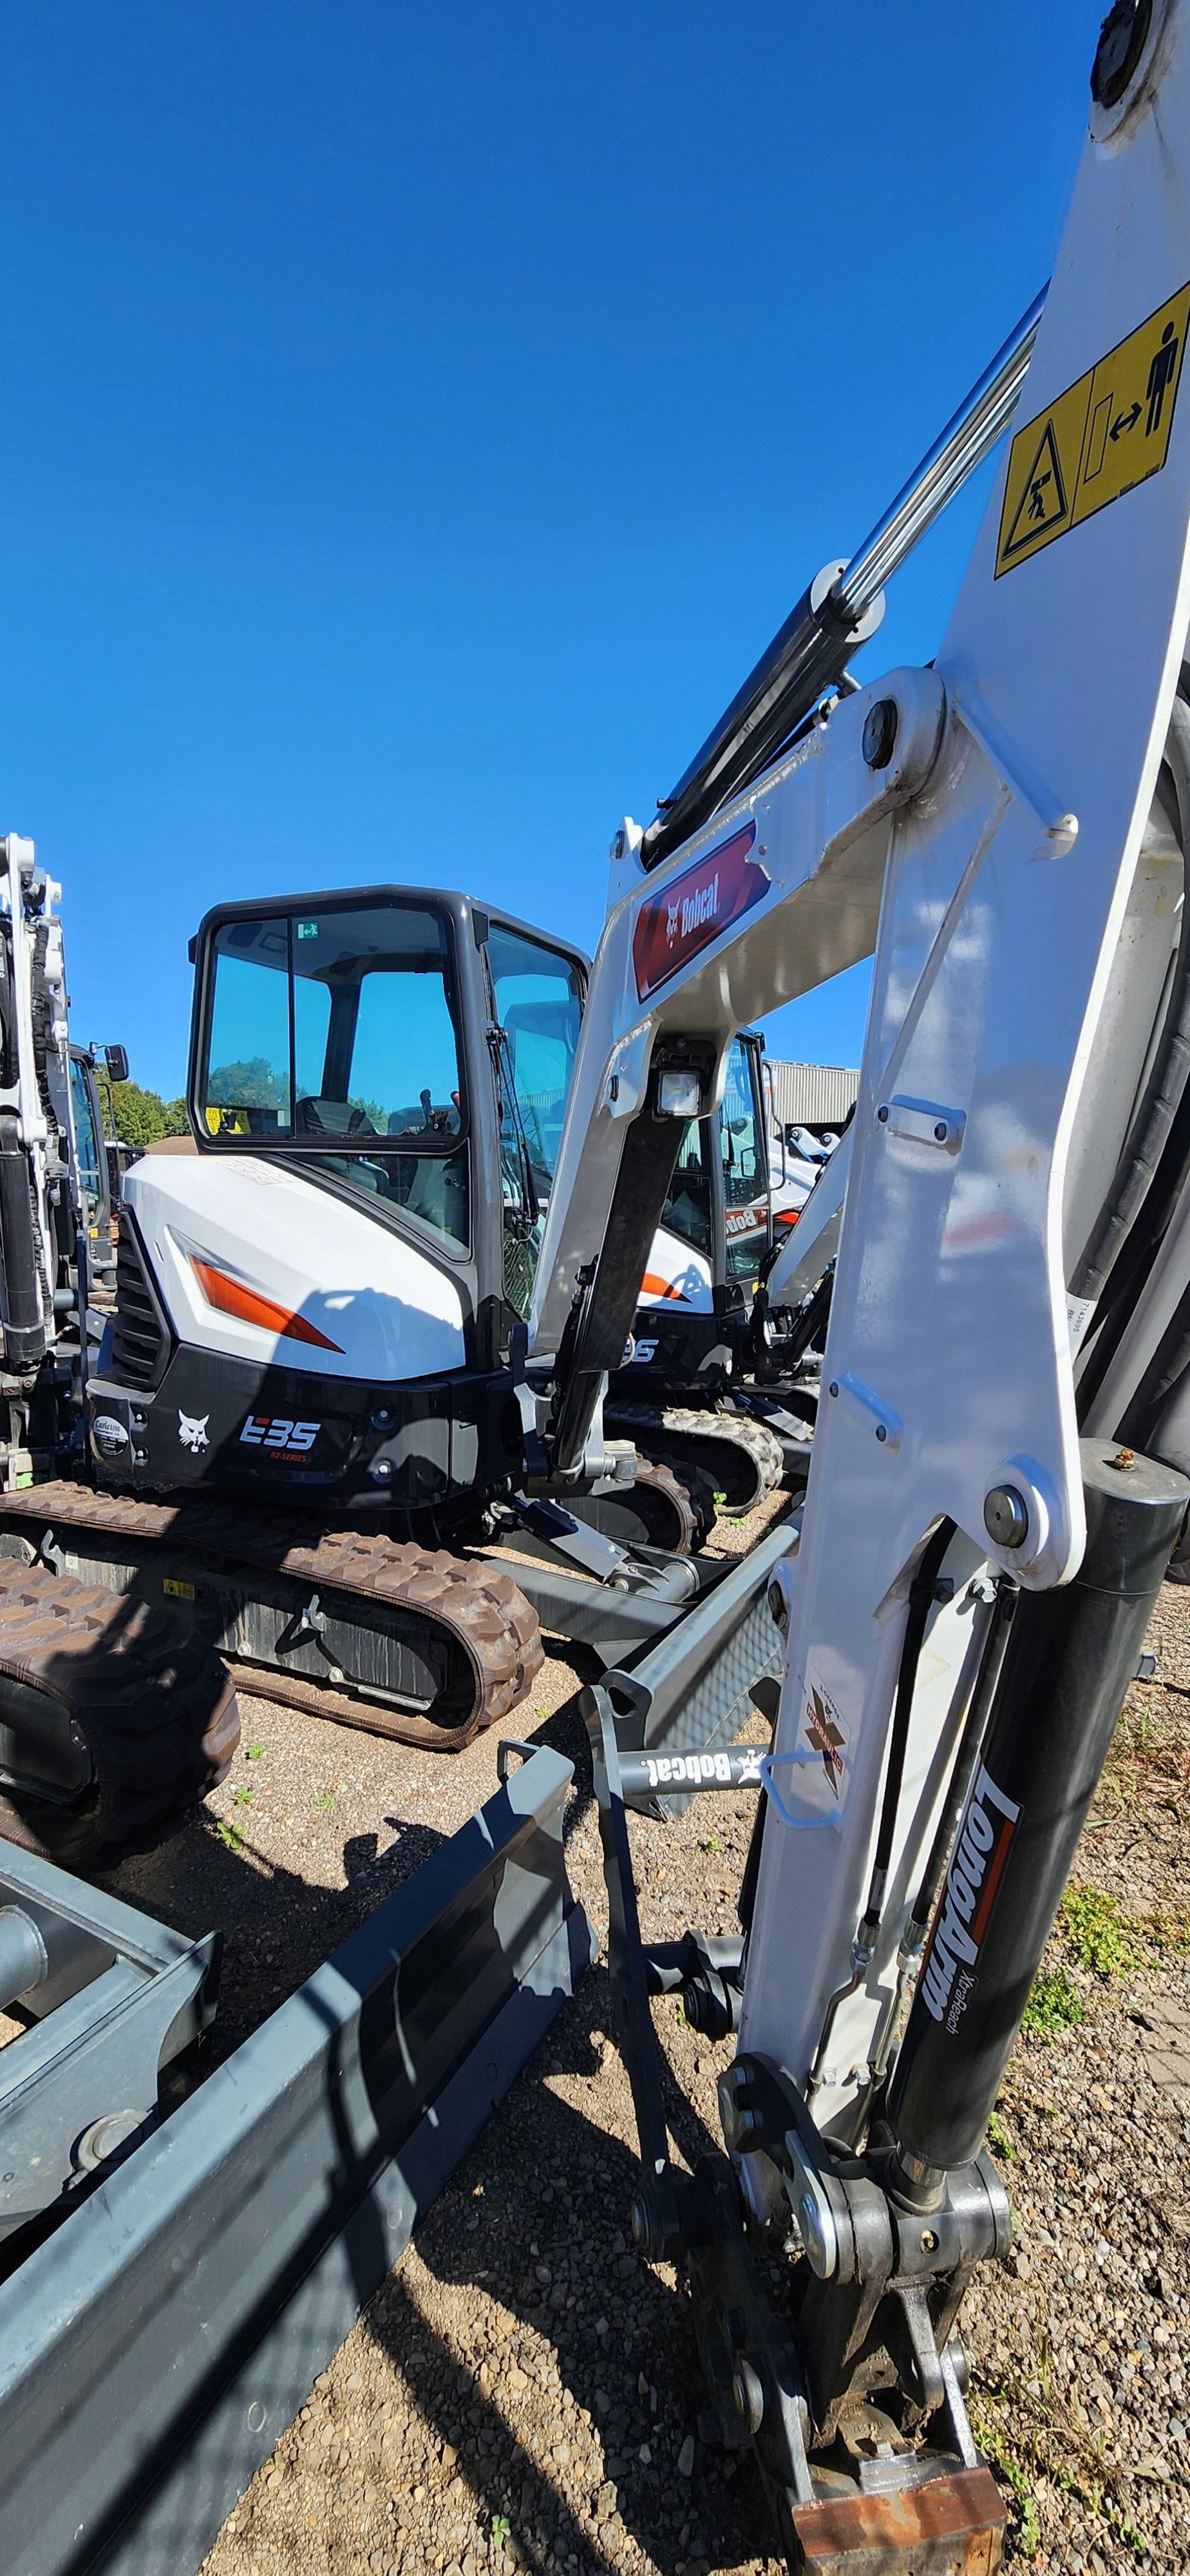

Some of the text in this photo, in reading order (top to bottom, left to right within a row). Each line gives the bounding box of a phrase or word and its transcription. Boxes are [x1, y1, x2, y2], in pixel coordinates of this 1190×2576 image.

[681, 872, 719, 938] Bobcat
[239, 1416, 321, 1450] E35
[269, 1451, 307, 1463] R2-SERIES
[646, 1753, 732, 1787] Bobcat
[807, 1706, 842, 1770] HYDRAULIC
[921, 1763, 1021, 2022] LongArm
[945, 1969, 975, 2035] XtraReach
